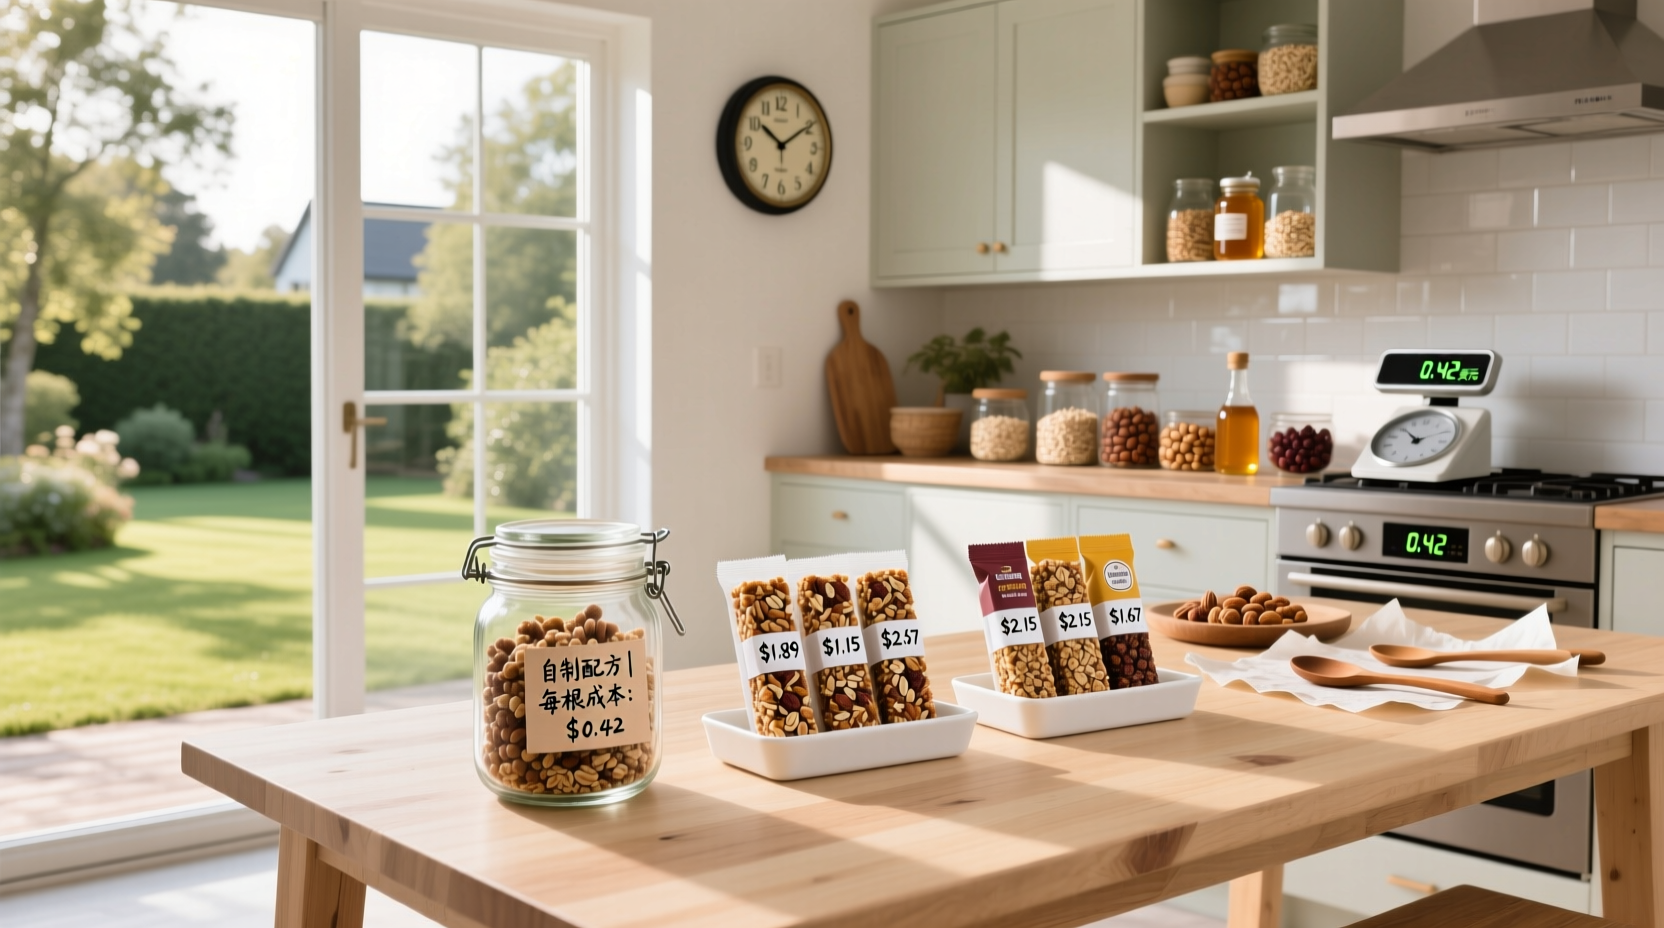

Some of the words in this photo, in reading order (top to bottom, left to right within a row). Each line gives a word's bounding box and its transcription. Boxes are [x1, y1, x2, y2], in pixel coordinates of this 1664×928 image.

[761, 100, 770, 116] 11
[775, 96, 787, 112] 12
[749, 116, 760, 132] 10
[805, 119, 814, 135] 2
[744, 136, 753, 151] 9
[810, 141, 818, 156] 3
[749, 157, 758, 173] 8
[805, 161, 813, 175] 4
[762, 173, 769, 189] 7
[777, 180, 786, 196] 6
[794, 176, 802, 191] 5
[1406, 531, 1448, 556] 0.42
[1109, 607, 1141, 625] $1.67
[759, 641, 799, 664] $1.89
[822, 636, 860, 656] $1.15
[538, 683, 633, 715] 每根成本:
[566, 716, 625, 744] $0.42
